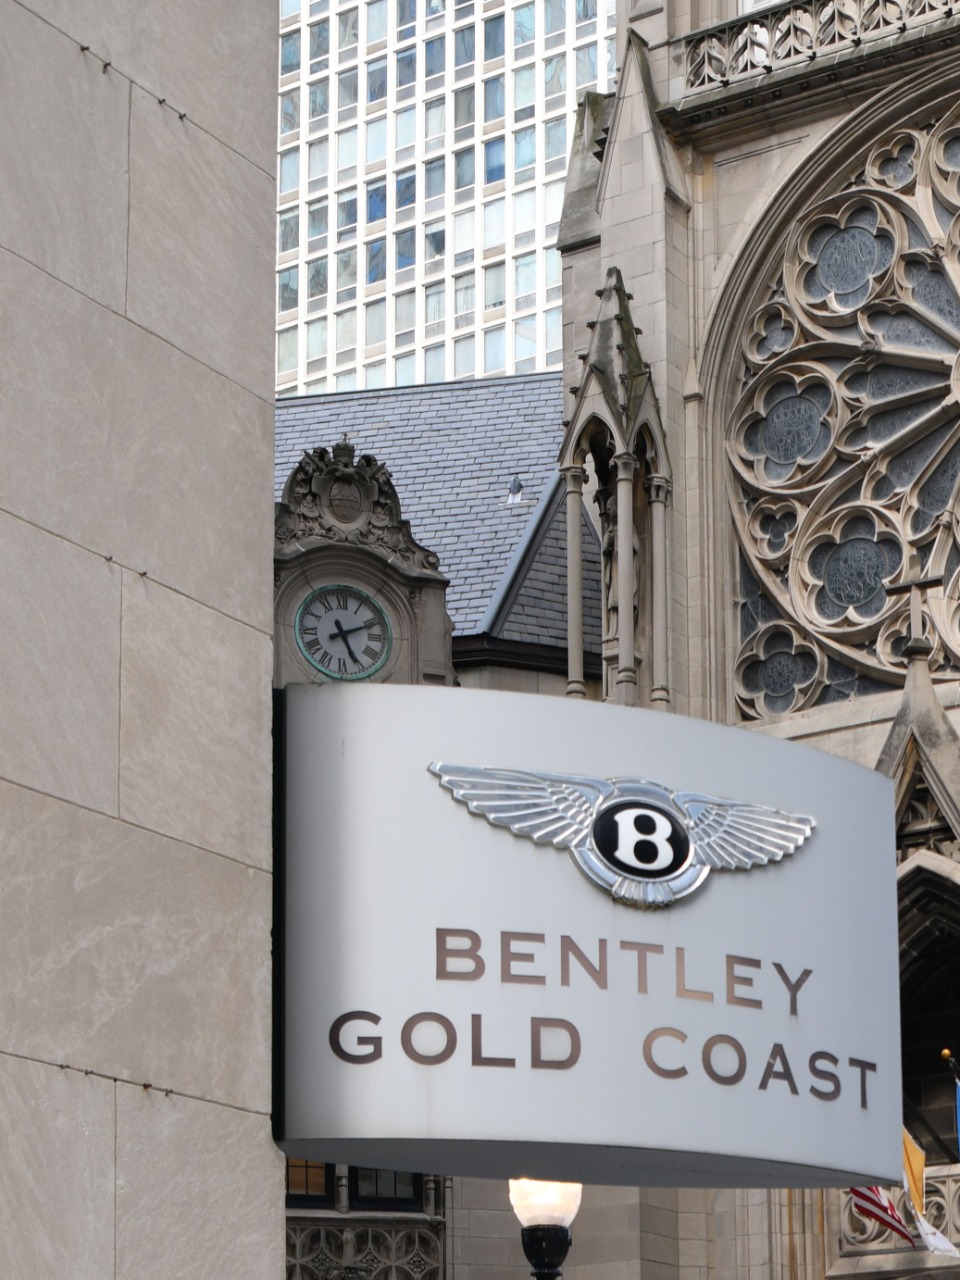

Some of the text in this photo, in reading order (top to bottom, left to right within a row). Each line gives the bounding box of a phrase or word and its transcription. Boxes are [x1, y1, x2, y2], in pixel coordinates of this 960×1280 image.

[613, 807, 675, 871] B
[435, 927, 813, 1016] BENTLEY
[328, 1010, 877, 1109] GOLD COAST
